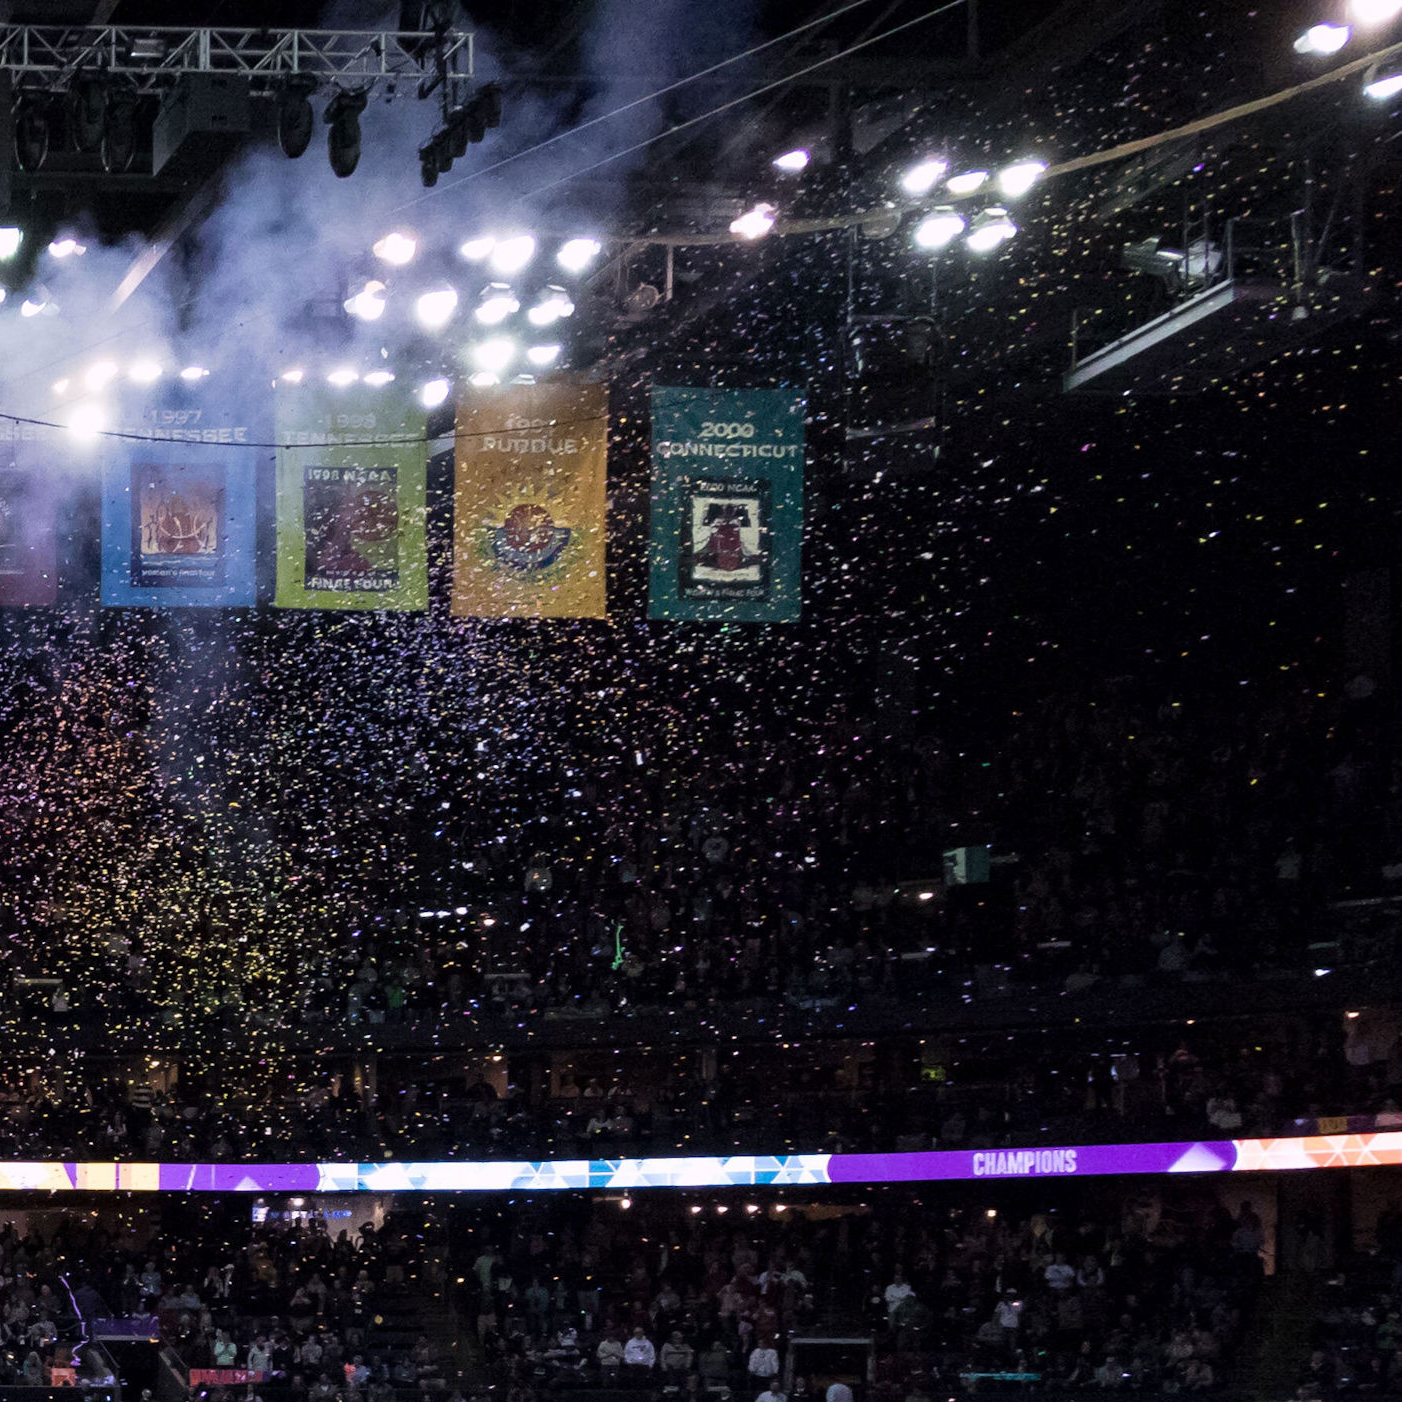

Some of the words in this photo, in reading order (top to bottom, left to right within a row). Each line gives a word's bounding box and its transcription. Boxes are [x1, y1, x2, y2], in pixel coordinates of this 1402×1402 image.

[150, 409, 203, 425] 1997
[116, 427, 248, 443] ENNESSEE
[698, 421, 755, 438] 2000
[482, 437, 578, 454] PURDUE
[656, 442, 799, 458] CONNECTICUT
[973, 1149, 1078, 1176] CHAMPIONS
